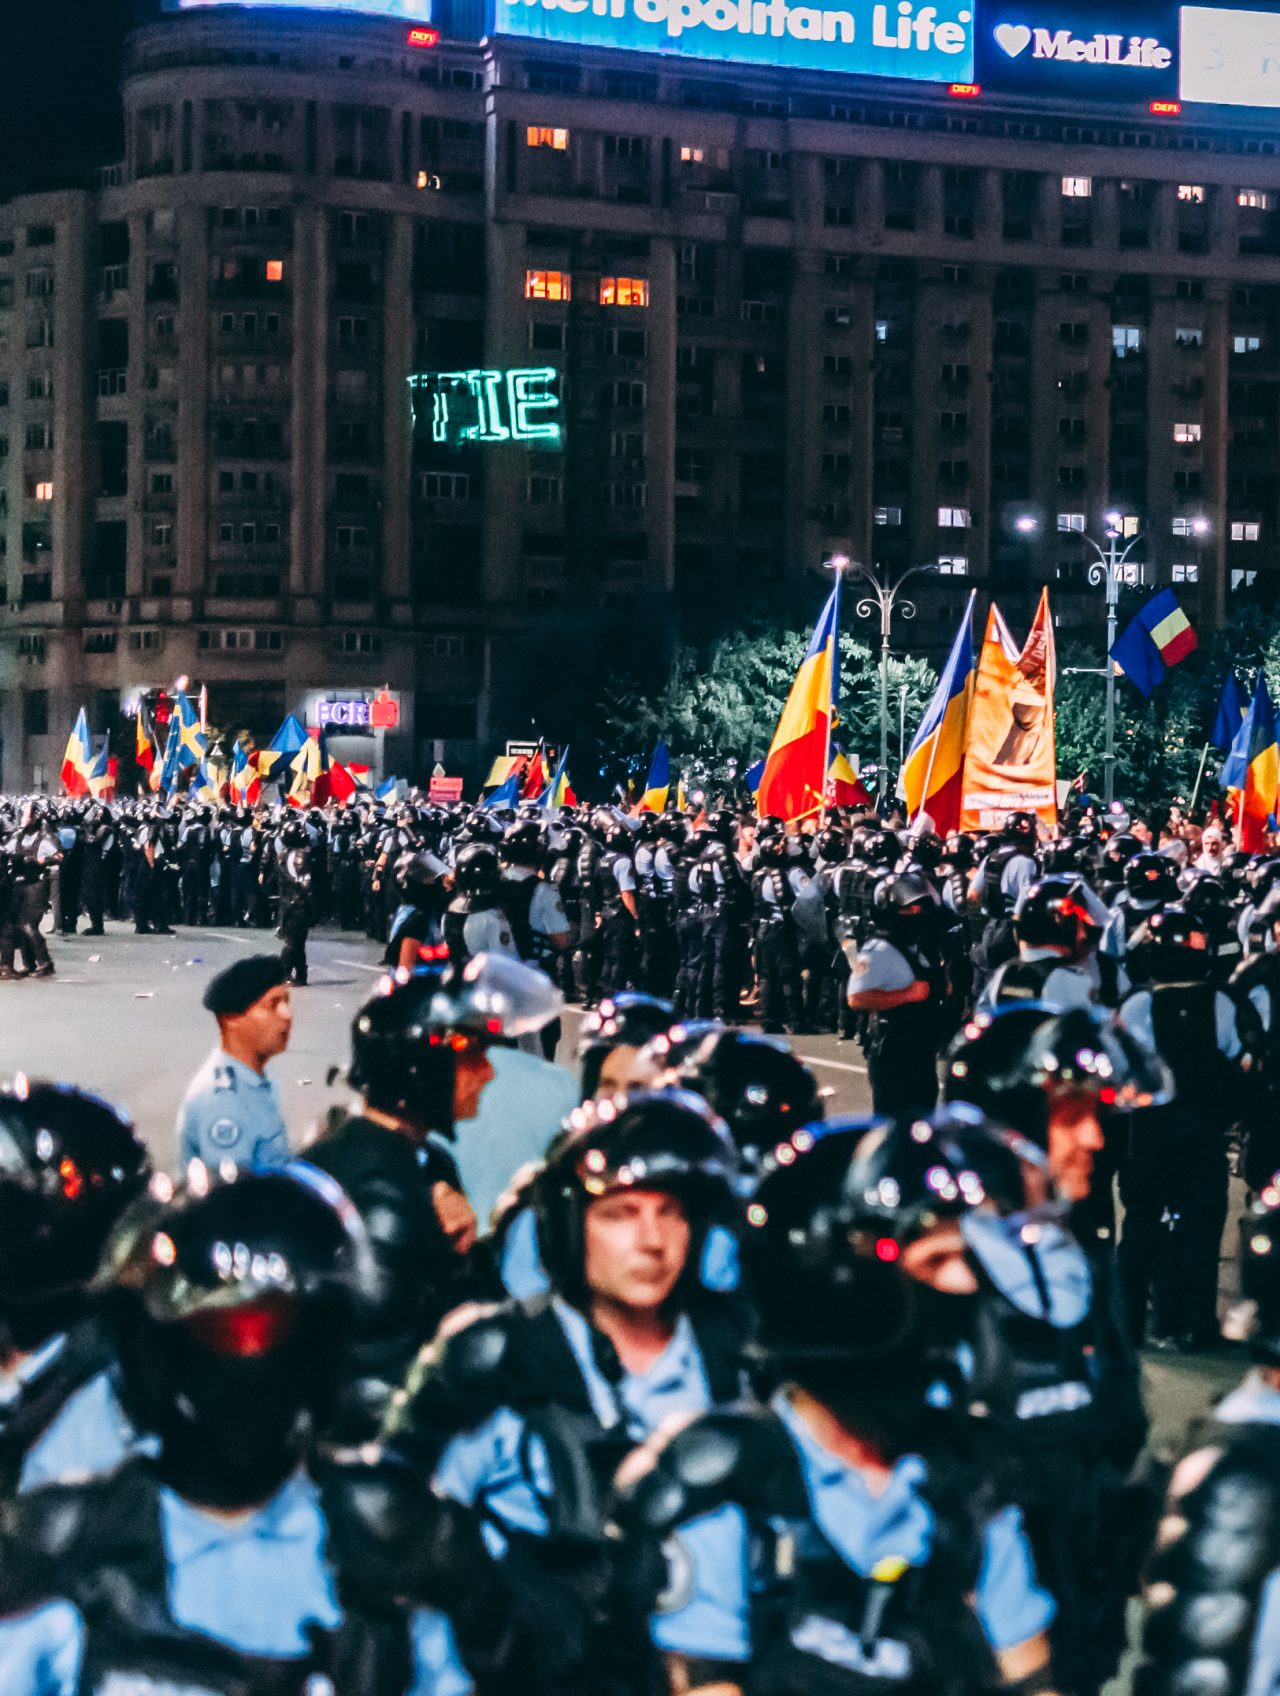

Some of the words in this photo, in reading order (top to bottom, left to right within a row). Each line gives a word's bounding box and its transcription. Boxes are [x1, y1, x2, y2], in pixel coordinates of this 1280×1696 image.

[504, 0, 855, 43] opolitan
[873, 1, 965, 54] Life
[1032, 27, 1172, 68] MedLife
[316, 701, 369, 724] BCR
